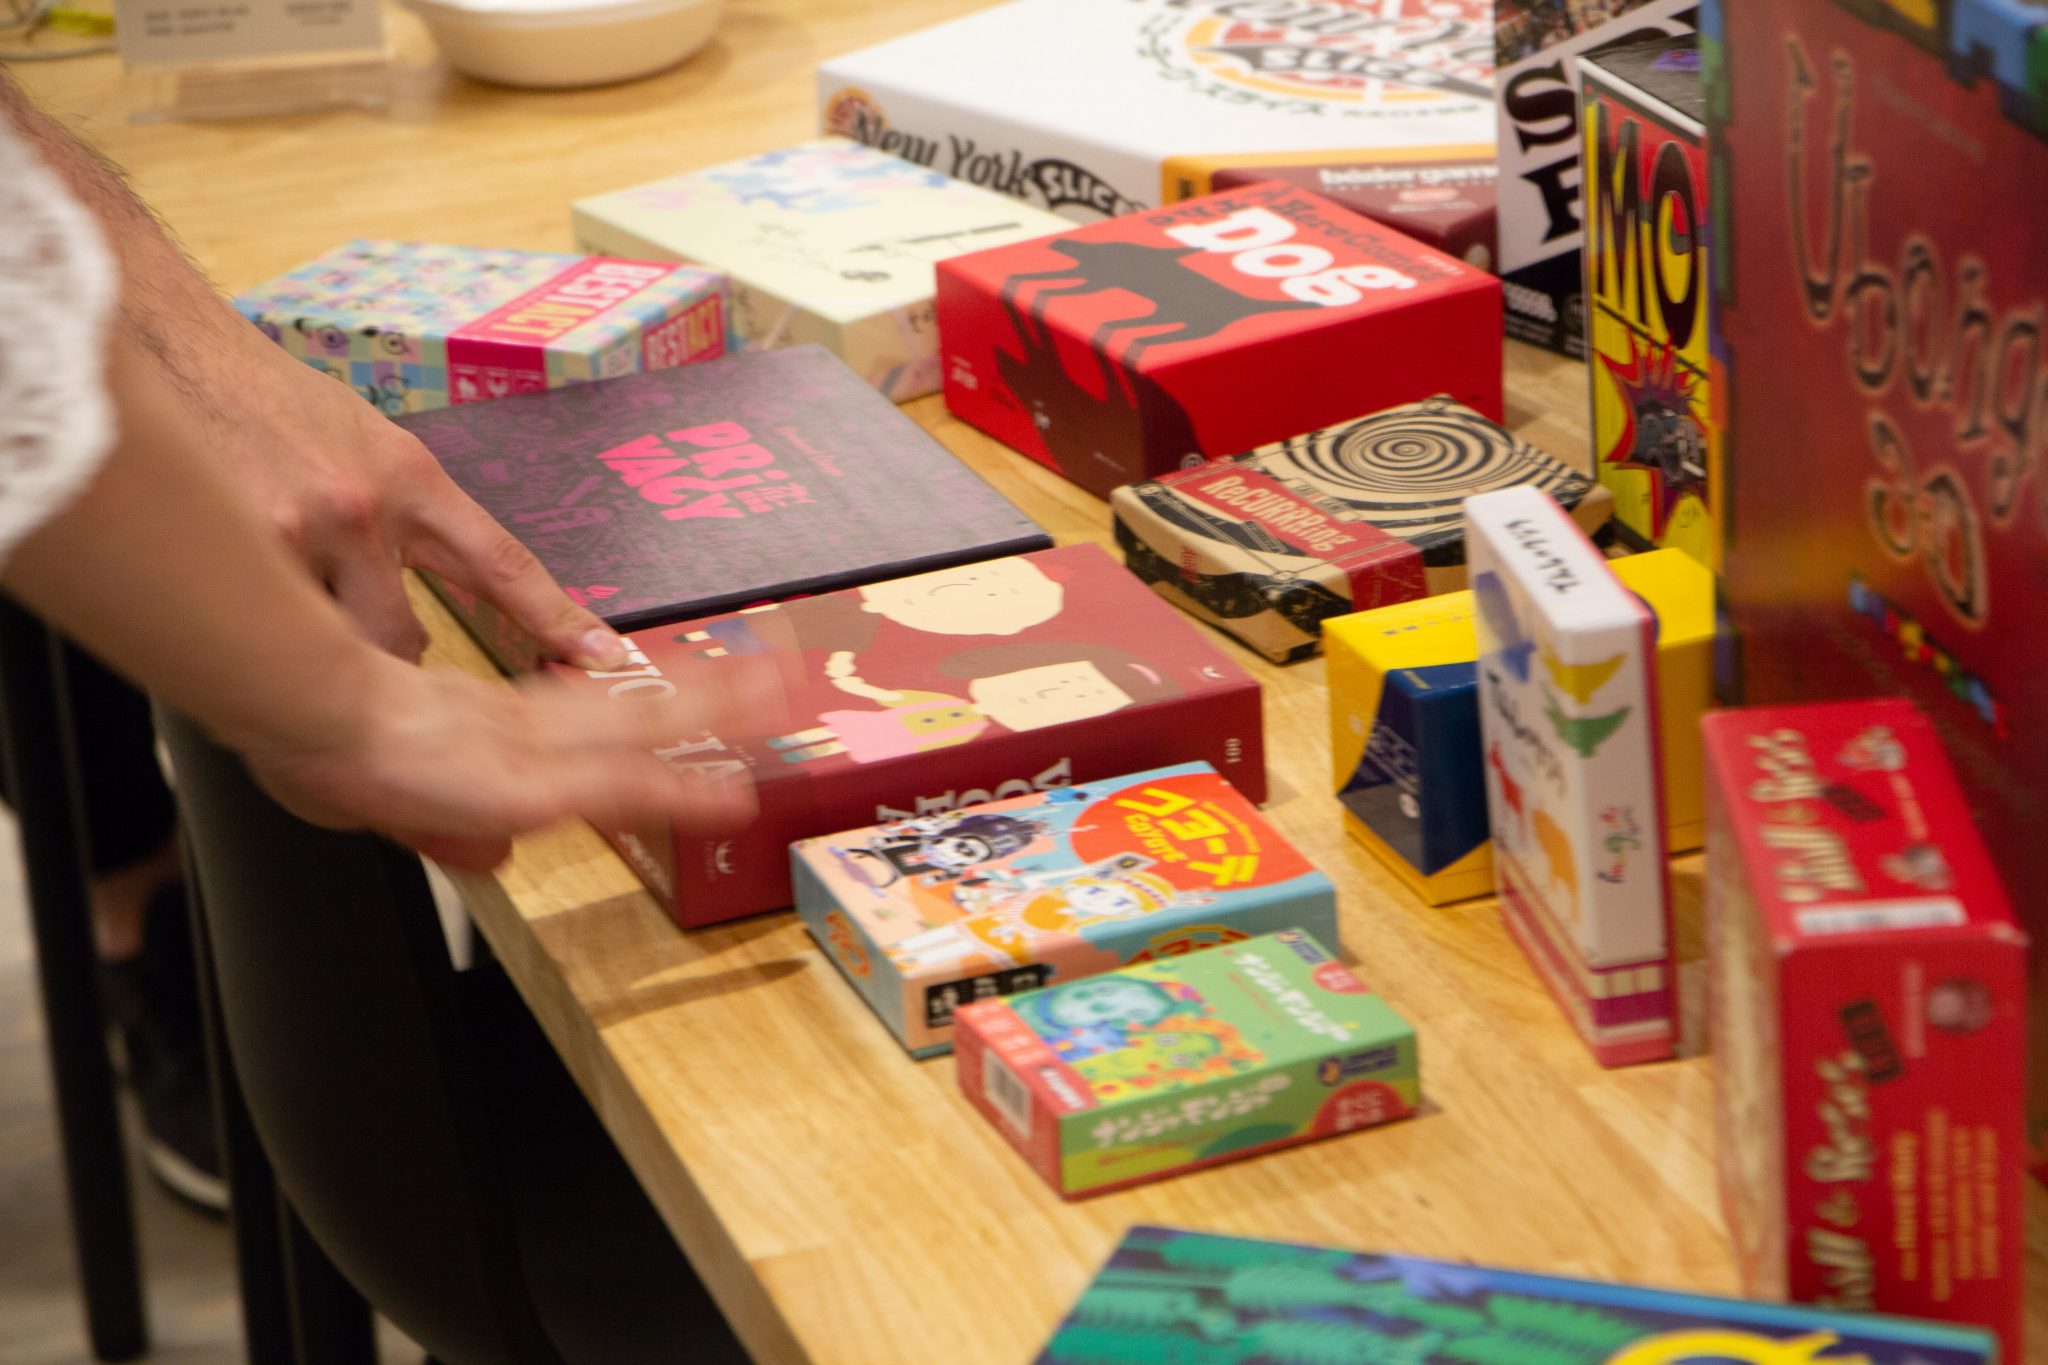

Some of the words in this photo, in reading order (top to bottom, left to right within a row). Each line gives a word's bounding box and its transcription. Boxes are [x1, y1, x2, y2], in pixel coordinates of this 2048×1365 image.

[853, 108, 941, 168] New
[948, 133, 1032, 200] York
[1163, 207, 1418, 308] Dog
[1785, 33, 2048, 530] Ubong
[1114, 787, 1261, 887] コヨーテ
